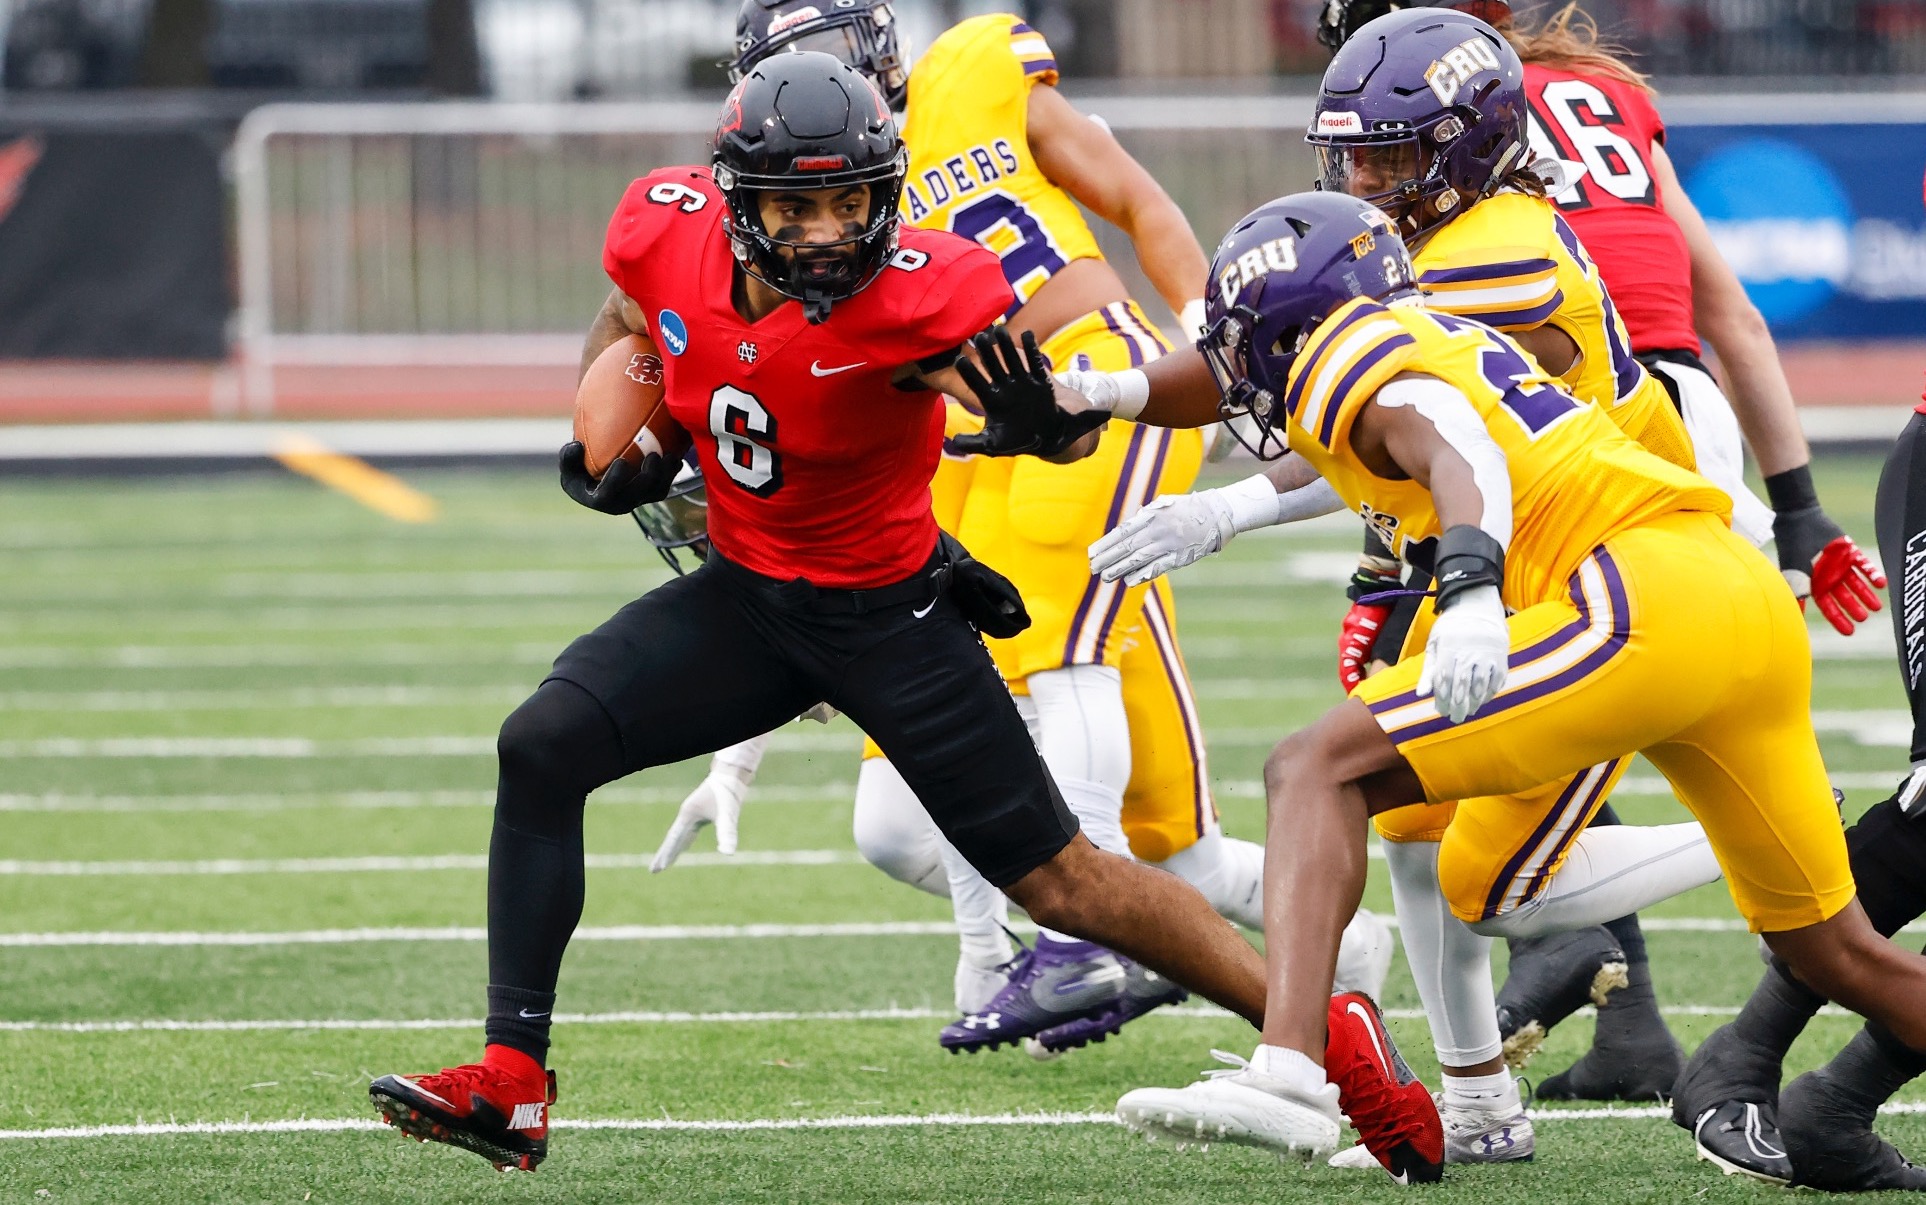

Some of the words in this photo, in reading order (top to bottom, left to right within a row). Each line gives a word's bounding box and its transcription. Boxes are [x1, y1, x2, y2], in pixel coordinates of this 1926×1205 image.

[1427, 37, 1501, 108] CRU
[899, 138, 1020, 224] ADERS
[1219, 236, 1299, 310] CRU
[661, 323, 686, 353] NCAA
[707, 381, 783, 498] 6
[506, 1101, 545, 1130] NIKE
